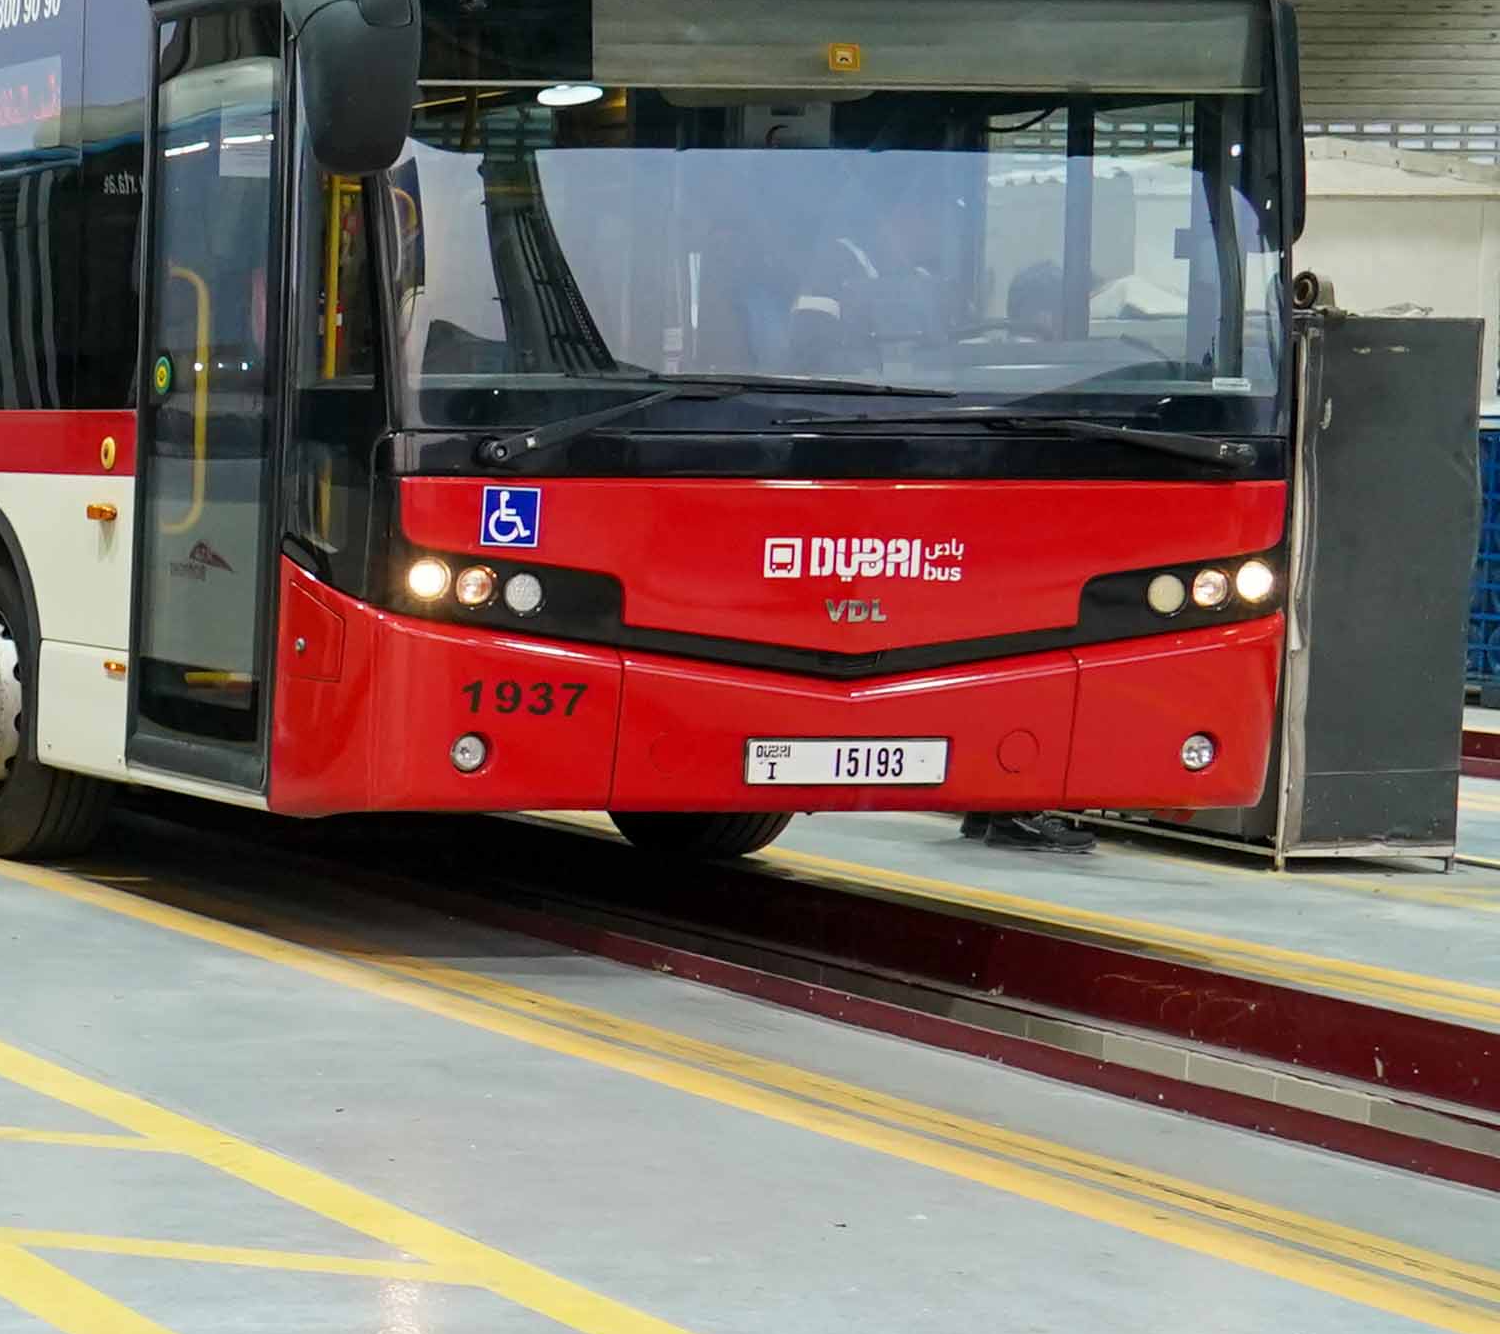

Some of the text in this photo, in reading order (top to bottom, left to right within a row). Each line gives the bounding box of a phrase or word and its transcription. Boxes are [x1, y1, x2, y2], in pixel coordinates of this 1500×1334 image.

[809, 537, 921, 582] DUBAI
[923, 563, 961, 581] bus
[825, 598, 887, 622] VDL
[462, 680, 588, 716] 1937
[835, 747, 904, 777] 15193
